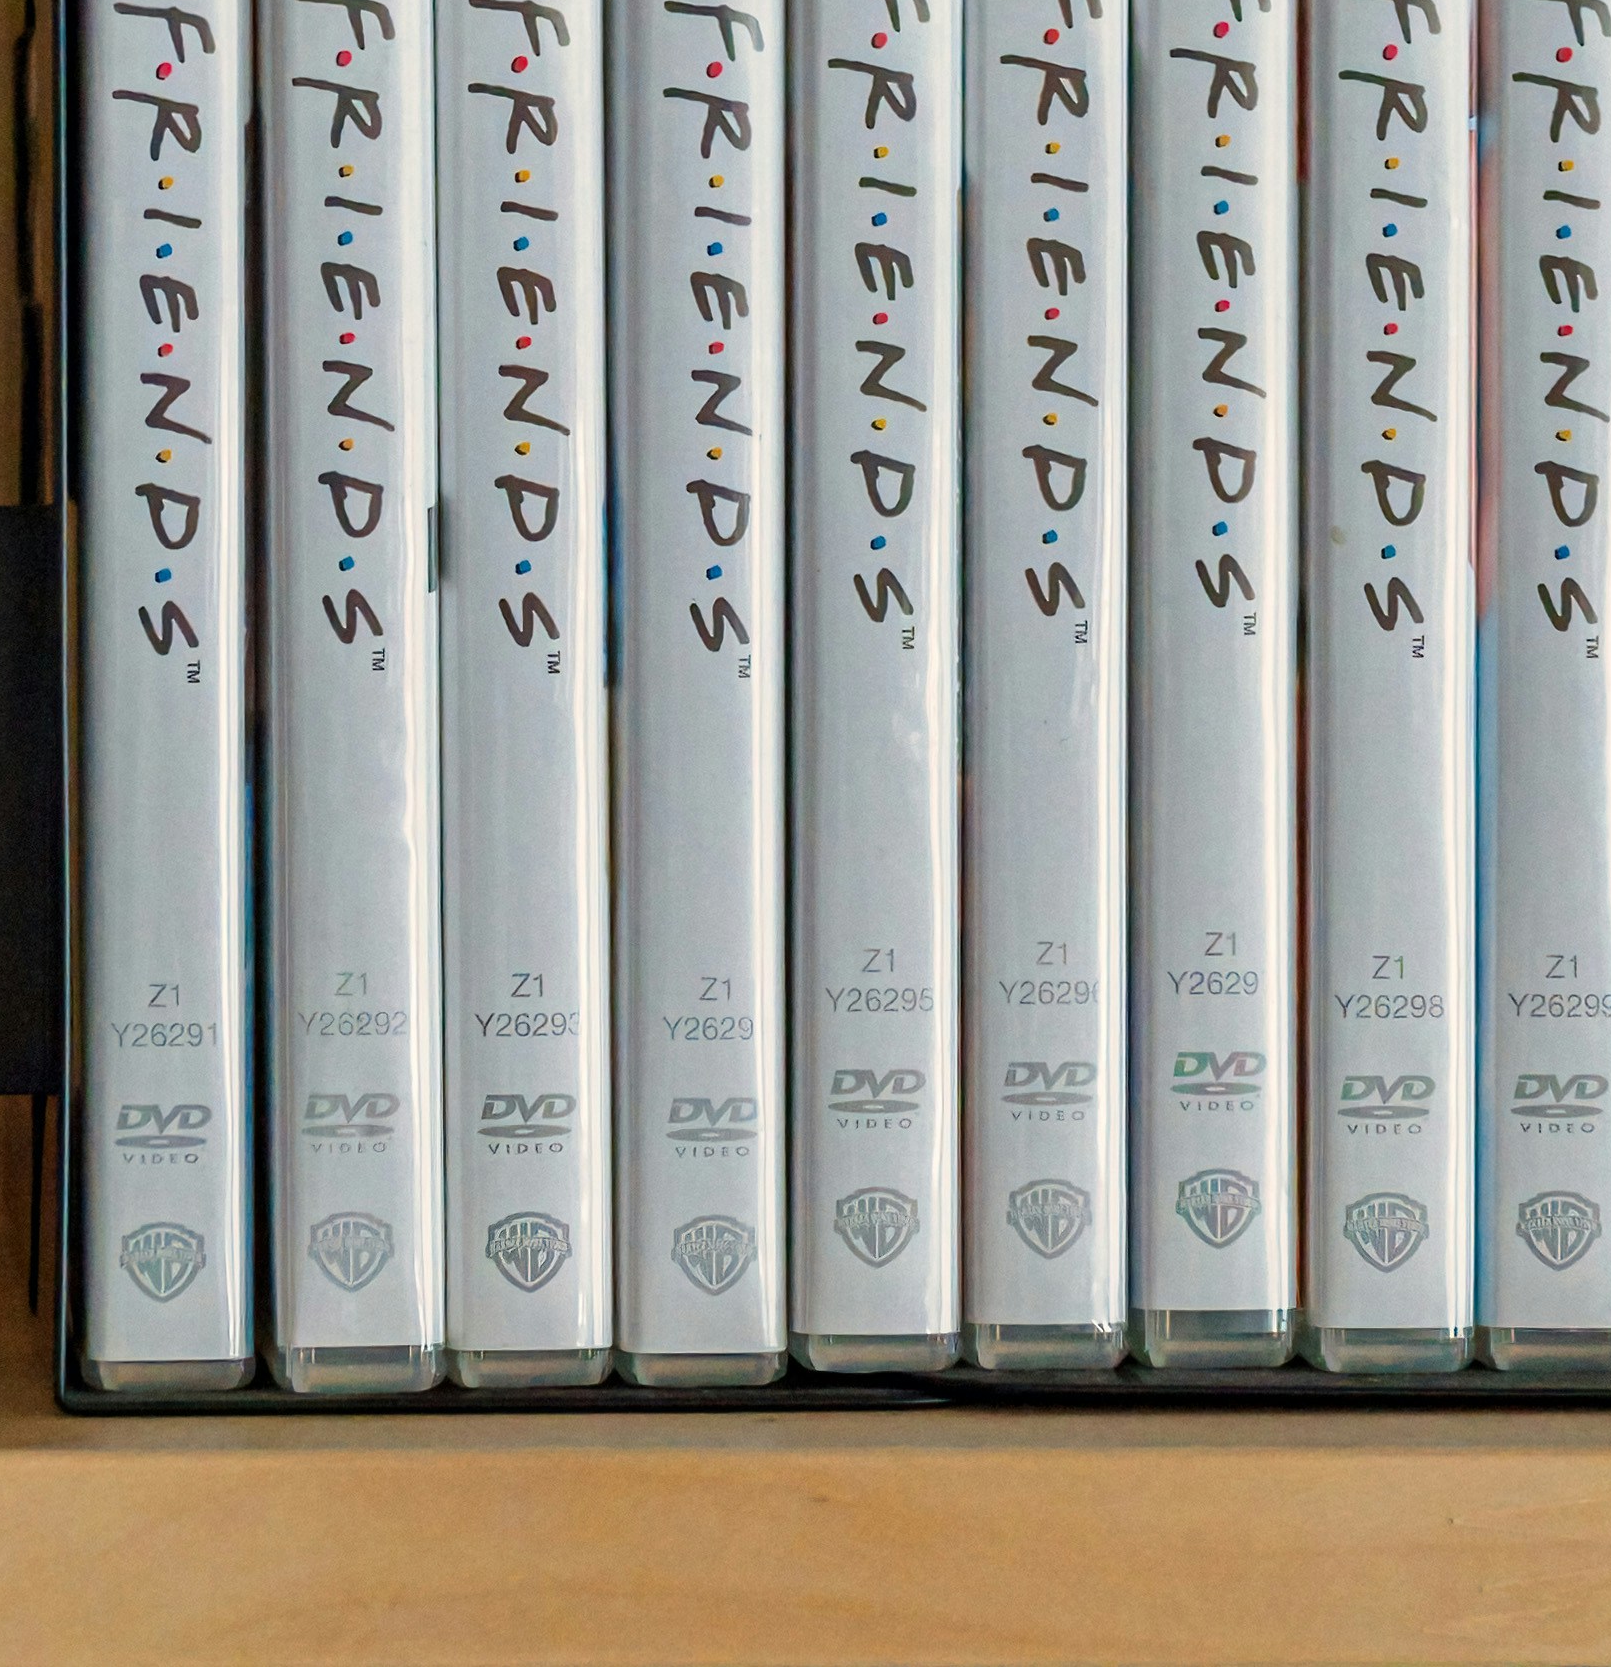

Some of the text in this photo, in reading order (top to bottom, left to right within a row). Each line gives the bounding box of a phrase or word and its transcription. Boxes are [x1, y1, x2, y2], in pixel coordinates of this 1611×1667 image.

[1036, 942, 1067, 965] Z1
[1205, 933, 1236, 955] Z1
[862, 949, 894, 972] Z1
[1372, 956, 1403, 979] Z1
[1545, 955, 1577, 978] Z1
[335, 973, 367, 995] Z1
[511, 973, 543, 997] Z1
[699, 977, 731, 1001] Z1
[1167, 971, 1258, 994] Y2629
[148, 984, 180, 1007] Z1
[1335, 995, 1444, 1018] Y26298
[298, 1011, 407, 1035] Y26292
[663, 1016, 753, 1040] Y2629
[112, 1023, 217, 1047] Y26291
[1004, 1062, 1097, 1090] DVD
[1173, 1051, 1266, 1081] DVD
[830, 1069, 926, 1098] DVD
[1340, 1075, 1436, 1104] DVD
[1514, 1074, 1609, 1103] DVD
[304, 1093, 400, 1123] DVD
[481, 1094, 576, 1123] DVD
[668, 1097, 758, 1126] DVD
[1011, 1111, 1084, 1121] VIDEO
[1180, 1101, 1254, 1111] VIDEO
[116, 1104, 212, 1134] DVD
[837, 1119, 911, 1128] VIDEO
[1348, 1124, 1422, 1134] VIDEO
[1521, 1123, 1594, 1133] VIDEO
[123, 1153, 199, 1164] VIDEO
[312, 1142, 386, 1153] VIDEO
[488, 1143, 563, 1155] VIDEO
[675, 1147, 749, 1157] VIDEO
